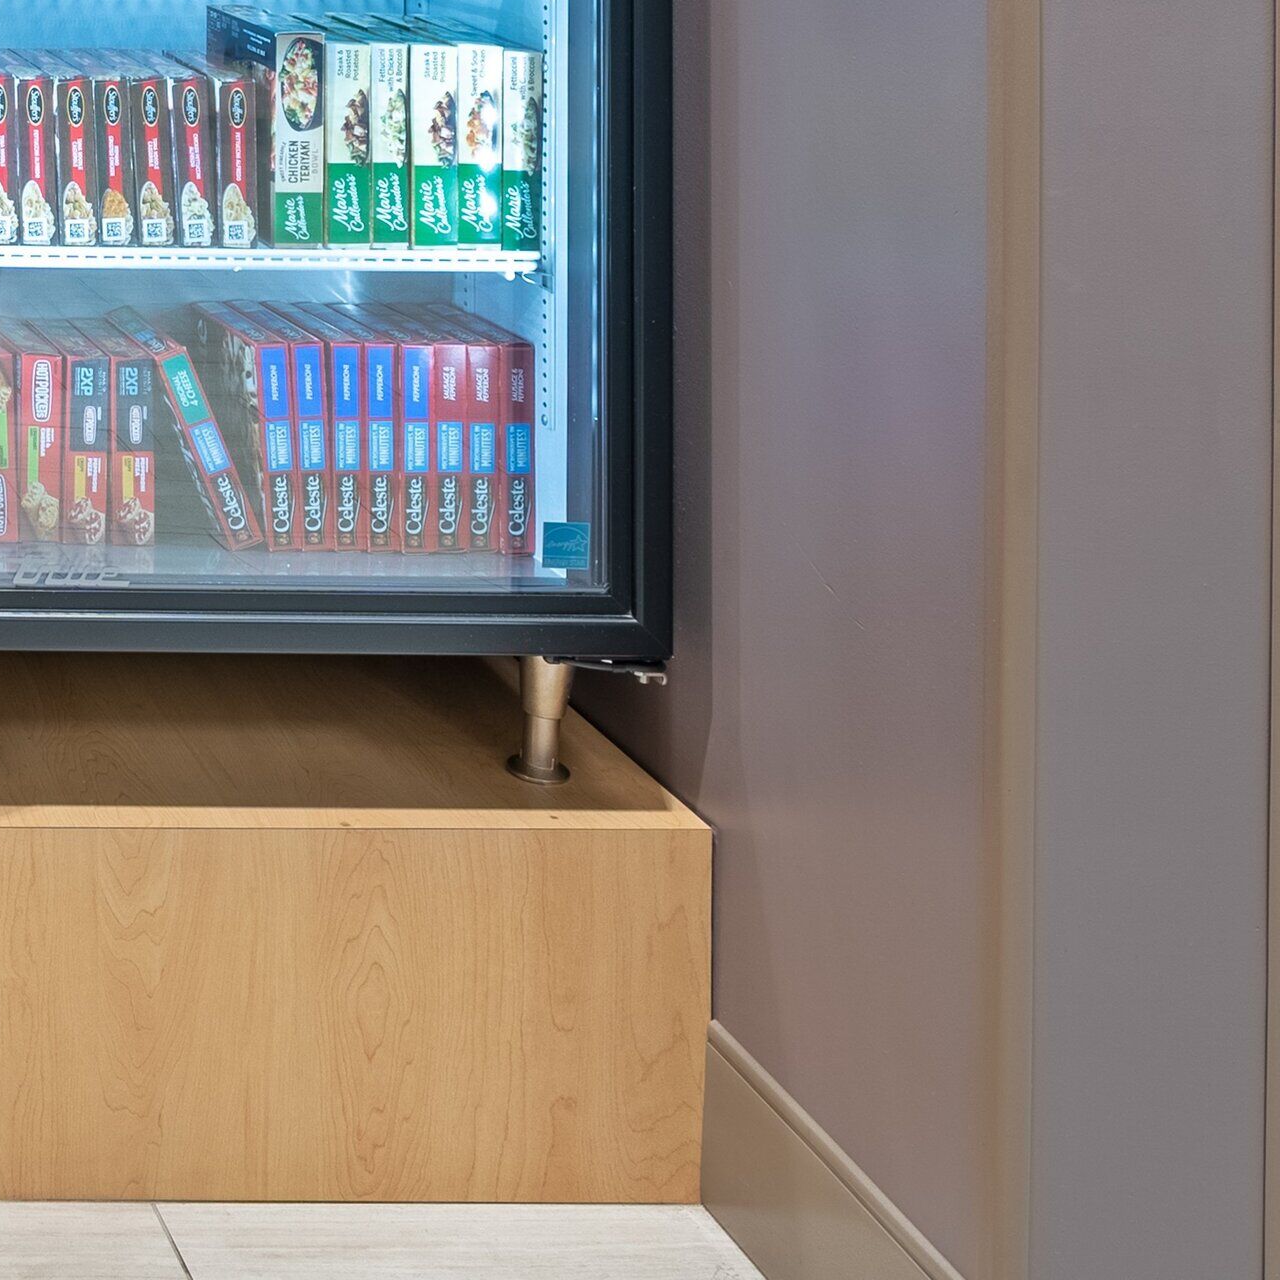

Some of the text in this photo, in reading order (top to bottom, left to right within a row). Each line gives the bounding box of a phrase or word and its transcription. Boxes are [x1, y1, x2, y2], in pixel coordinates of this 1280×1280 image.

[352, 49, 360, 81] Potatoes
[378, 48, 386, 83] Fettuccini
[387, 48, 395, 76] Chicken
[395, 48, 403, 76] Broccoli
[510, 56, 518, 91] Fettuccini
[470, 73, 479, 97] Sweet
[288, 139, 299, 184] CHICKEN
[299, 140, 310, 183] TERIYAKI
[284, 198, 297, 240] Marie
[332, 177, 350, 232] Marie
[376, 177, 394, 232] Marie
[419, 180, 438, 234] Marie
[462, 178, 480, 232] Marie
[505, 184, 524, 236] Marie
